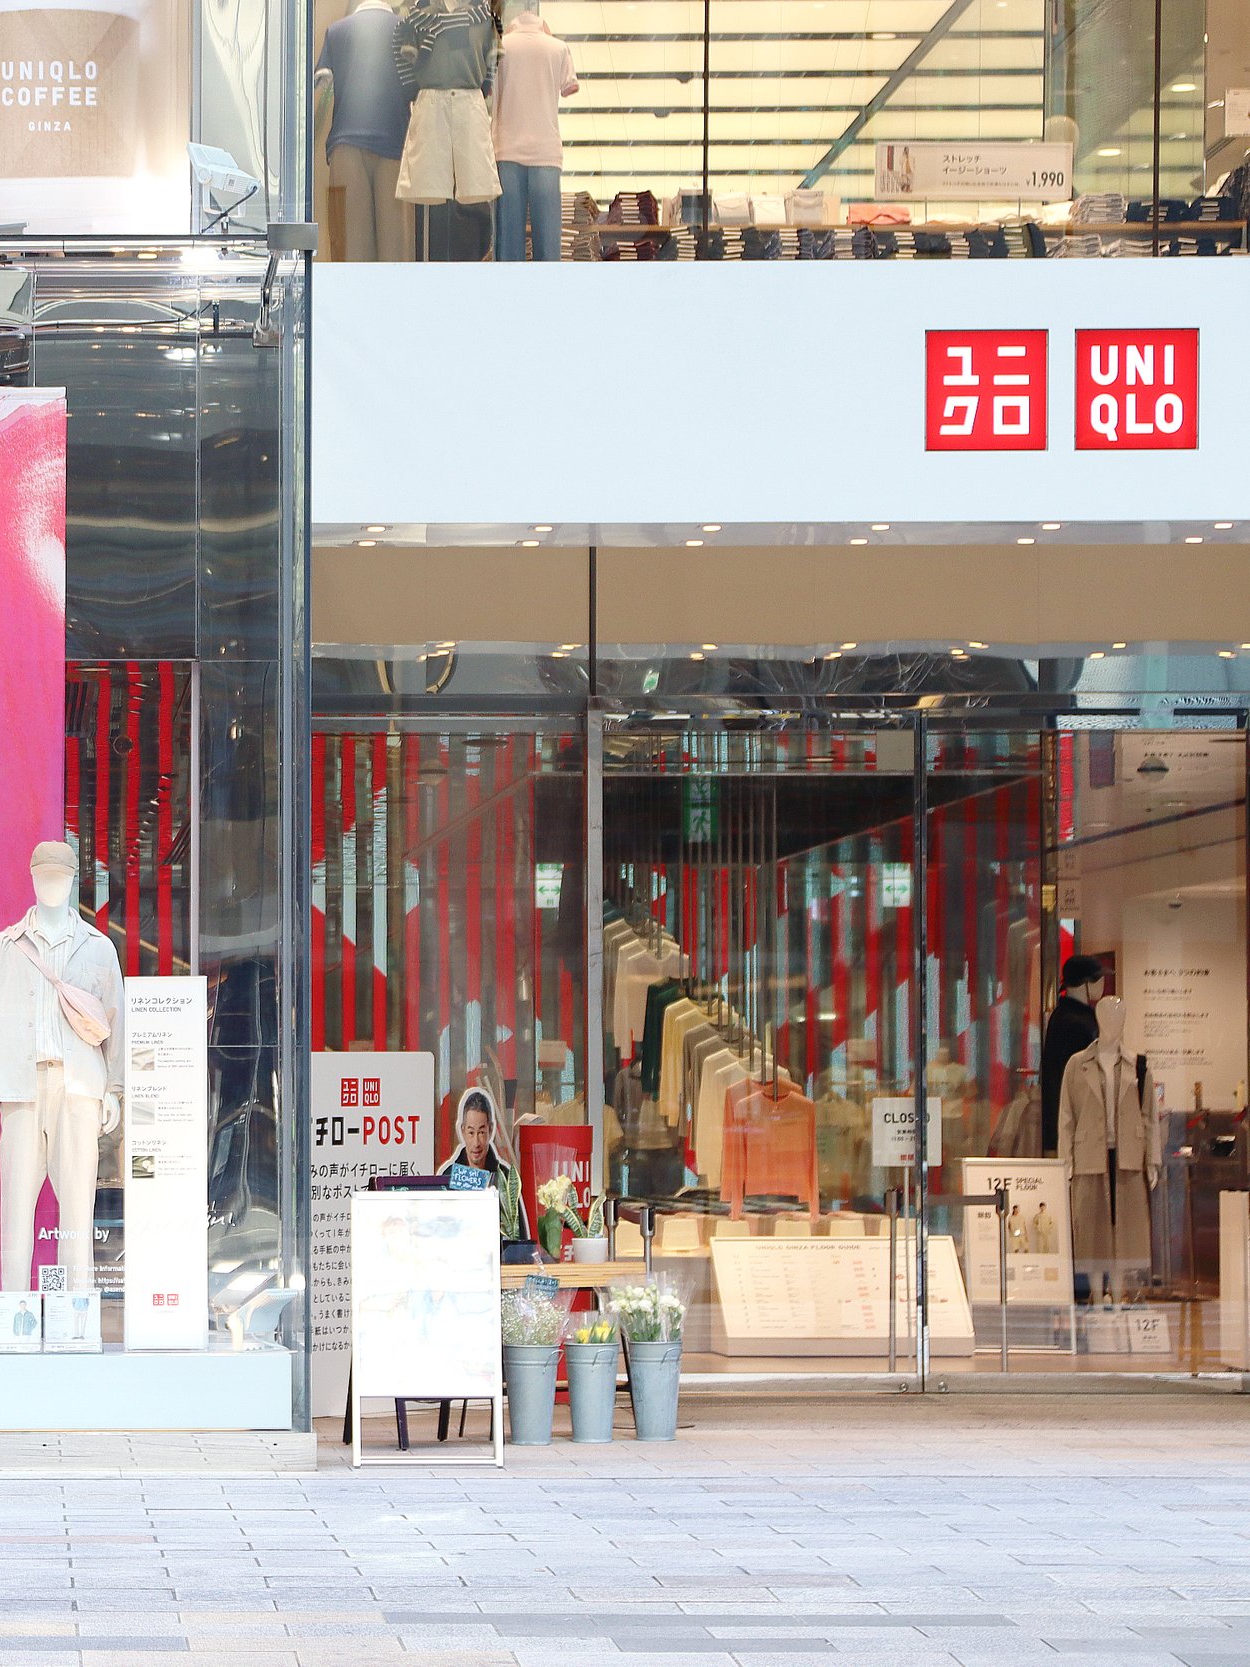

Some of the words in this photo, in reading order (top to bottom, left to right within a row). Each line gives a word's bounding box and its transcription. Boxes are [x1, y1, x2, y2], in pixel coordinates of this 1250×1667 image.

[1, 60, 97, 83] UNIQLO
[1, 86, 97, 106] COFFEE
[28, 121, 71, 131] GINZA
[131, 997, 193, 1005] リネンコレクション
[883, 1112, 931, 1124] CLOSD
[94, 1226, 110, 1243] by
